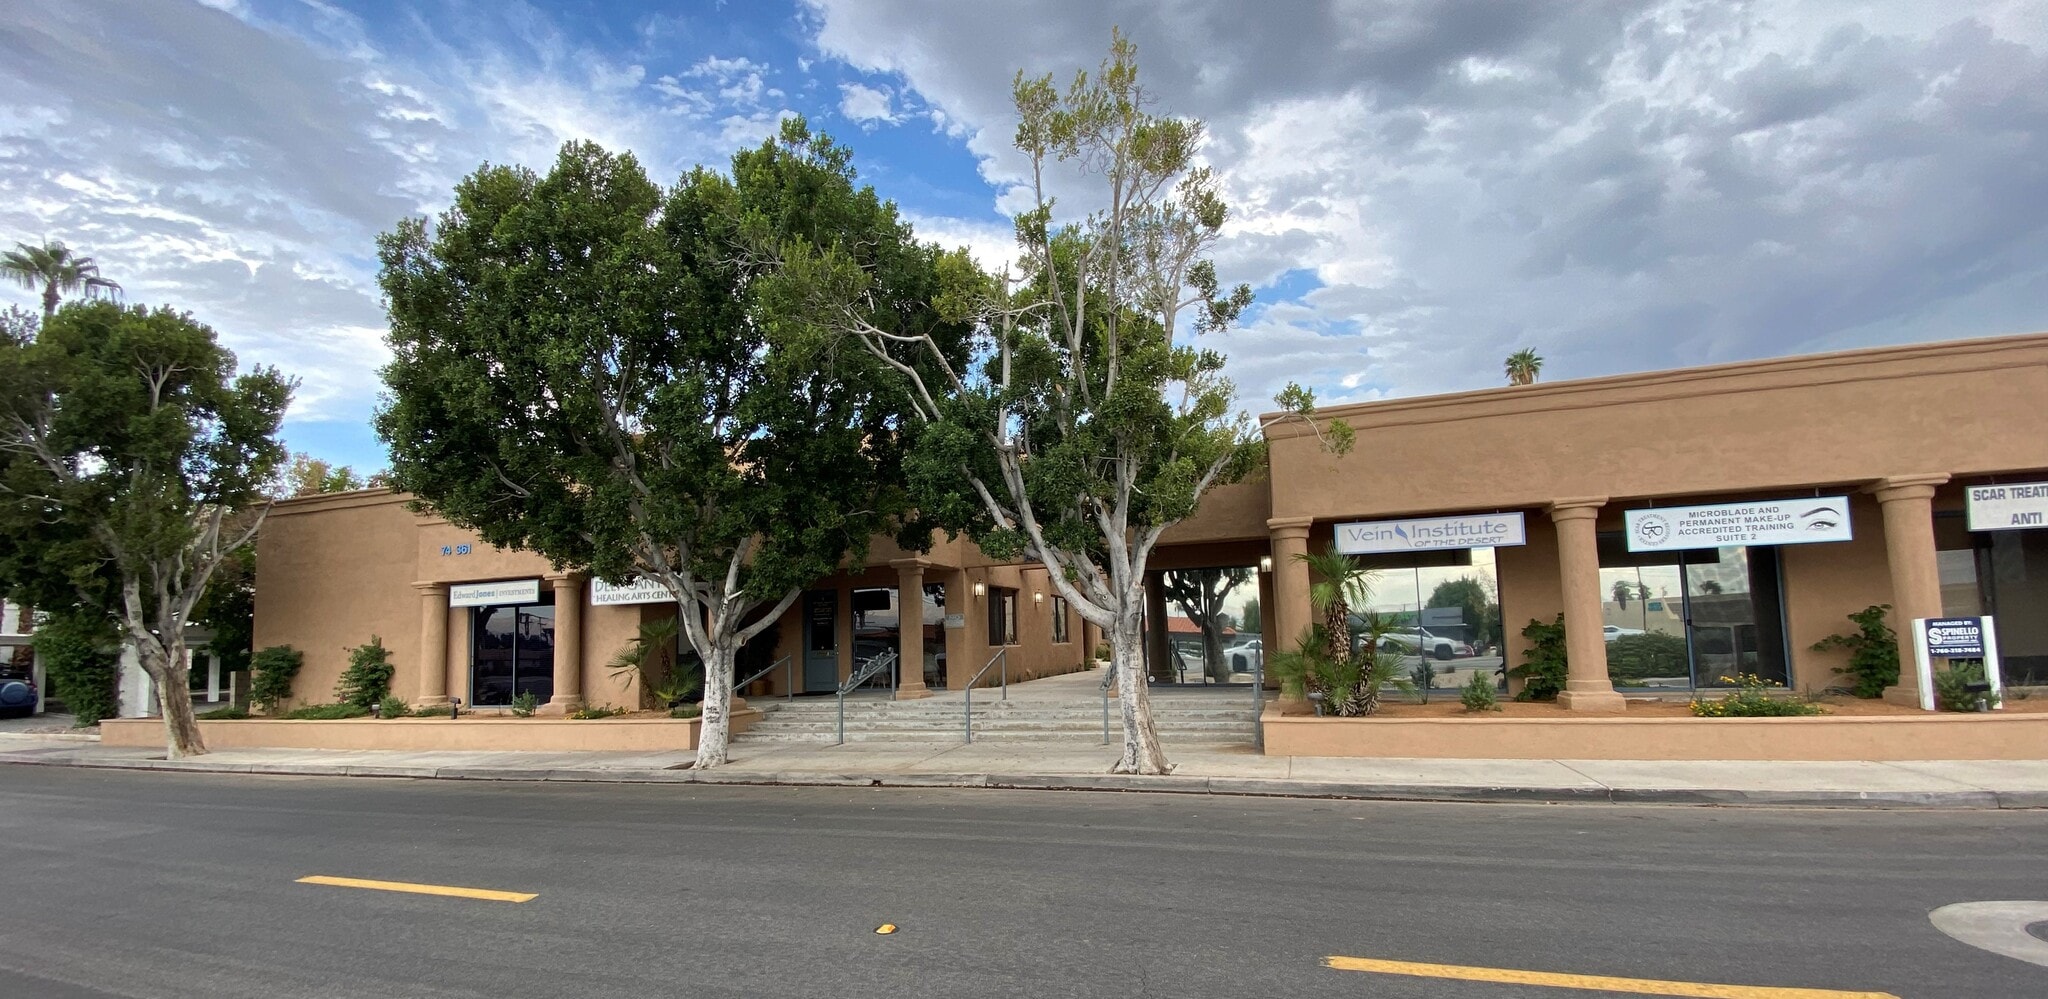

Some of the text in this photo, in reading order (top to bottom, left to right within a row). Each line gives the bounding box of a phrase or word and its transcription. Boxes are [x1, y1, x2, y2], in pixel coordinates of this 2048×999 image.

[1973, 488, 2006, 501] SCAR
[1688, 506, 1779, 518] MICROBLADE AND
[1679, 514, 1791, 527] PERMANENT MAKE-UP
[1348, 520, 1508, 542] Vein Institute
[1678, 522, 1795, 536] ACCREDITED TRAINING
[1414, 536, 1504, 548] OF THE DESERT
[1716, 534, 1747, 542] SUITE
[442, 544, 472, 556] 74 361
[499, 588, 535, 597] INVESTMENTS
[597, 590, 672, 603] HEALING ARTS CENT
[1942, 627, 1979, 636] SPINELLO
